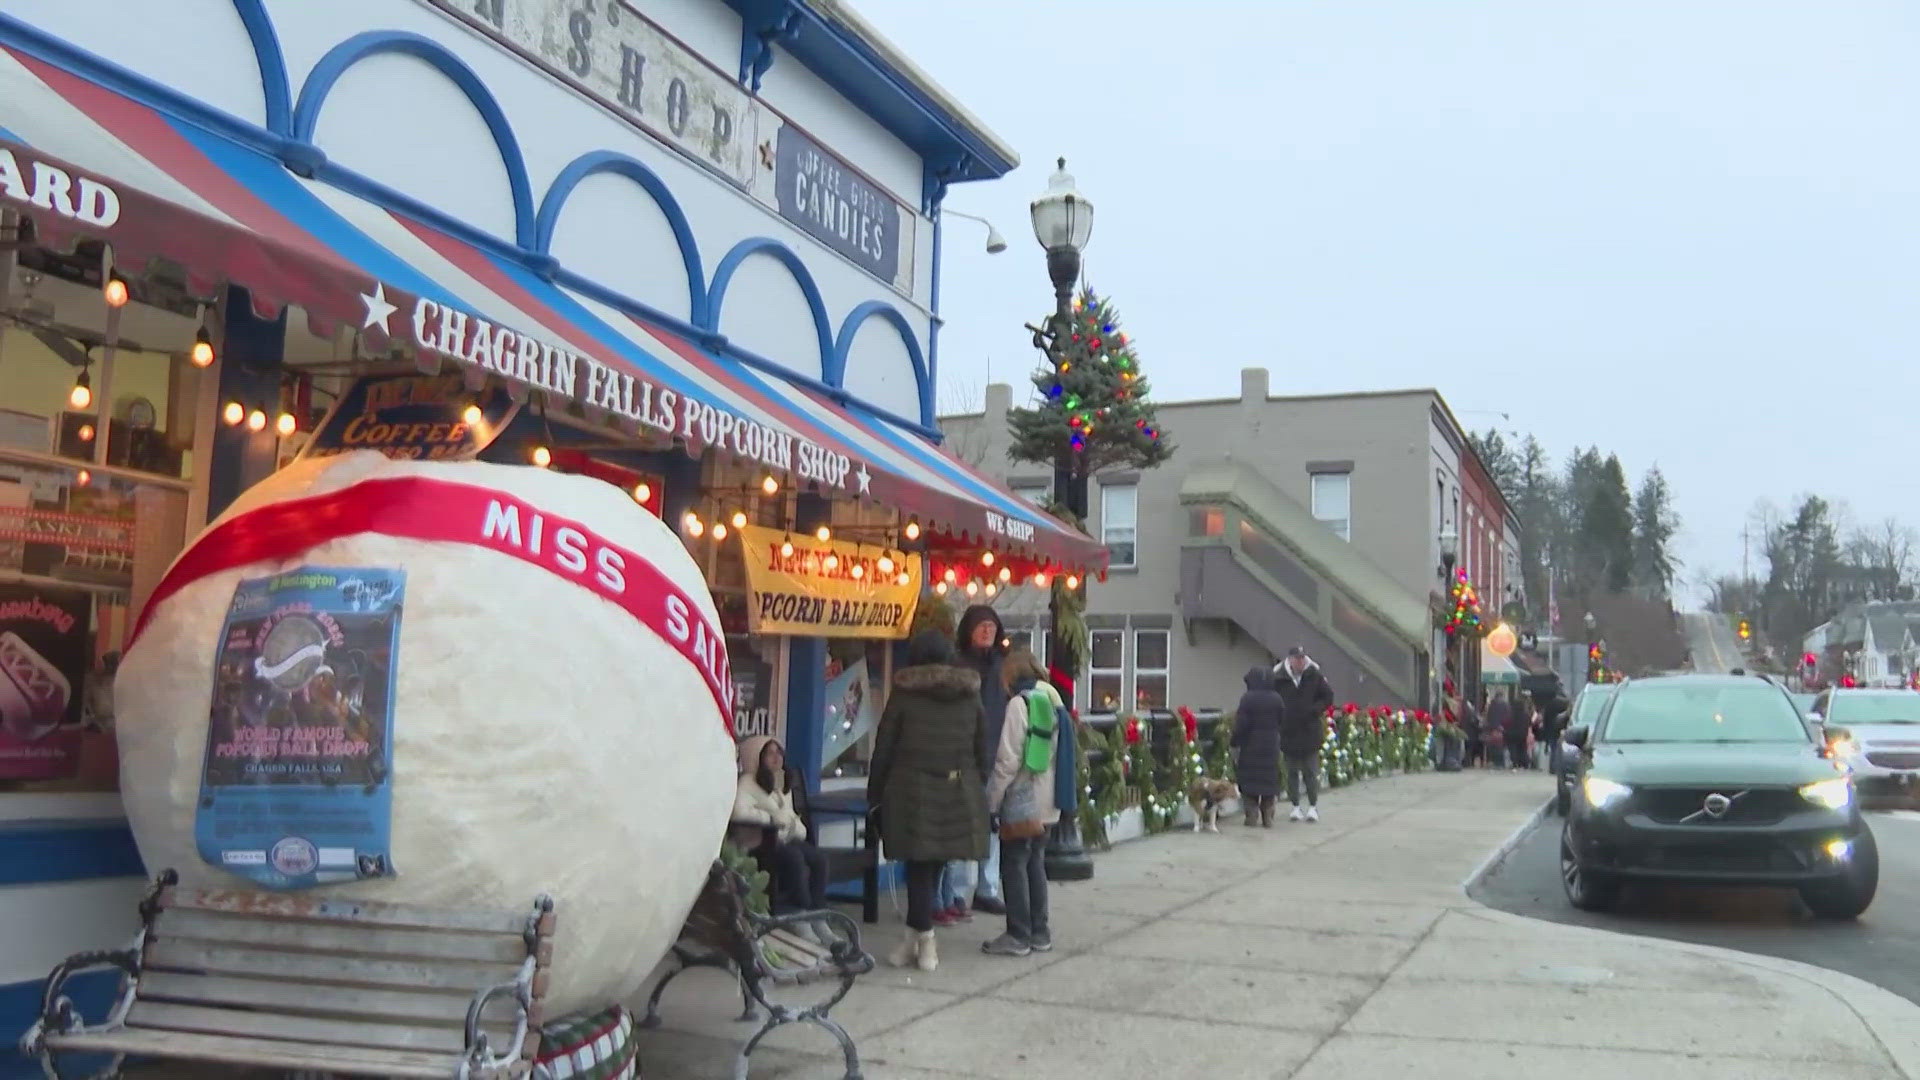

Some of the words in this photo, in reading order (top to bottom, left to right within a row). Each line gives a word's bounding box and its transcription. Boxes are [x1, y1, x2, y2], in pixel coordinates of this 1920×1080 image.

[567, 9, 732, 164] SHOP
[0, 148, 120, 229] ARD
[797, 150, 841, 196] COFFEE
[795, 171, 884, 261] CANDIES
[412, 297, 578, 398] CHAGRIN
[585, 360, 677, 434] FALLS
[681, 398, 793, 468] POPCORN
[797, 441, 852, 489] SHOP
[483, 499, 627, 594] MISS
[986, 510, 1005, 535] WE
[1006, 517, 1035, 543] SHIP!
[754, 591, 827, 624] PCORN
[828, 598, 867, 625] BALL
[866, 601, 903, 627] DROP
[233, 725, 281, 741] WORLD
[283, 725, 346, 741] FAMOUS
[280, 740, 320, 757] BALL
[322, 763, 342, 774] USA
